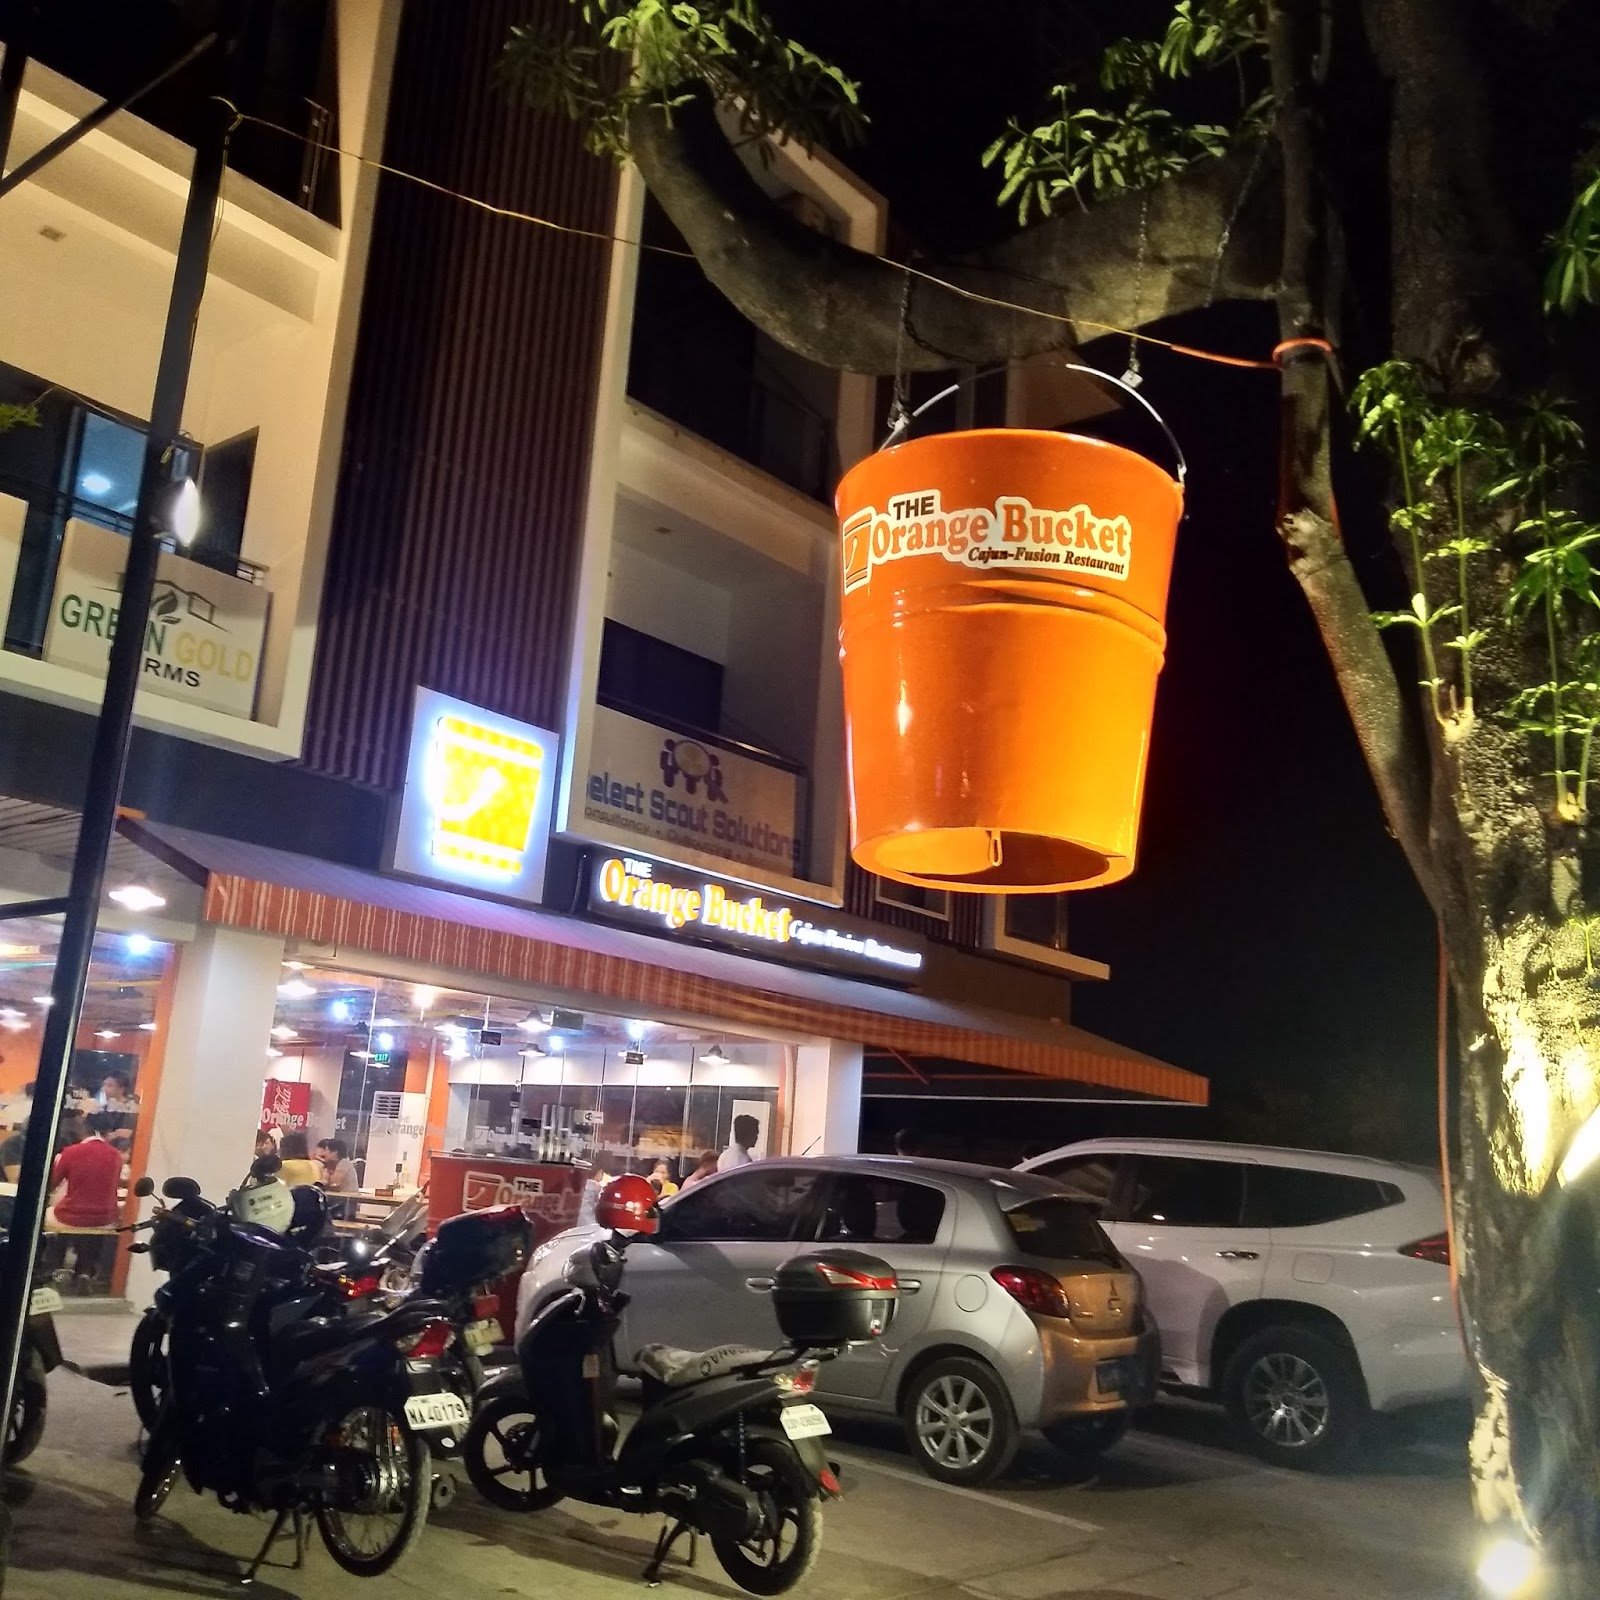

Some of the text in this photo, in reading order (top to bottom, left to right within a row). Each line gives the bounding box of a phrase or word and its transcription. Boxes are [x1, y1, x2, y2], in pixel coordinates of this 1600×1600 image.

[893, 496, 935, 521] THE
[872, 503, 1128, 558] Orange Bucket
[968, 546, 1125, 575] Cajun-Fusion Restaurant
[61, 593, 251, 682] GREN GOLD
[586, 772, 645, 815] elect
[650, 788, 708, 835] Scout
[623, 857, 653, 879] THE
[600, 858, 702, 929] Orange
[702, 884, 794, 943] Bucket
[374, 1053, 389, 1061] EXIT
[516, 1180, 540, 1193] THE
